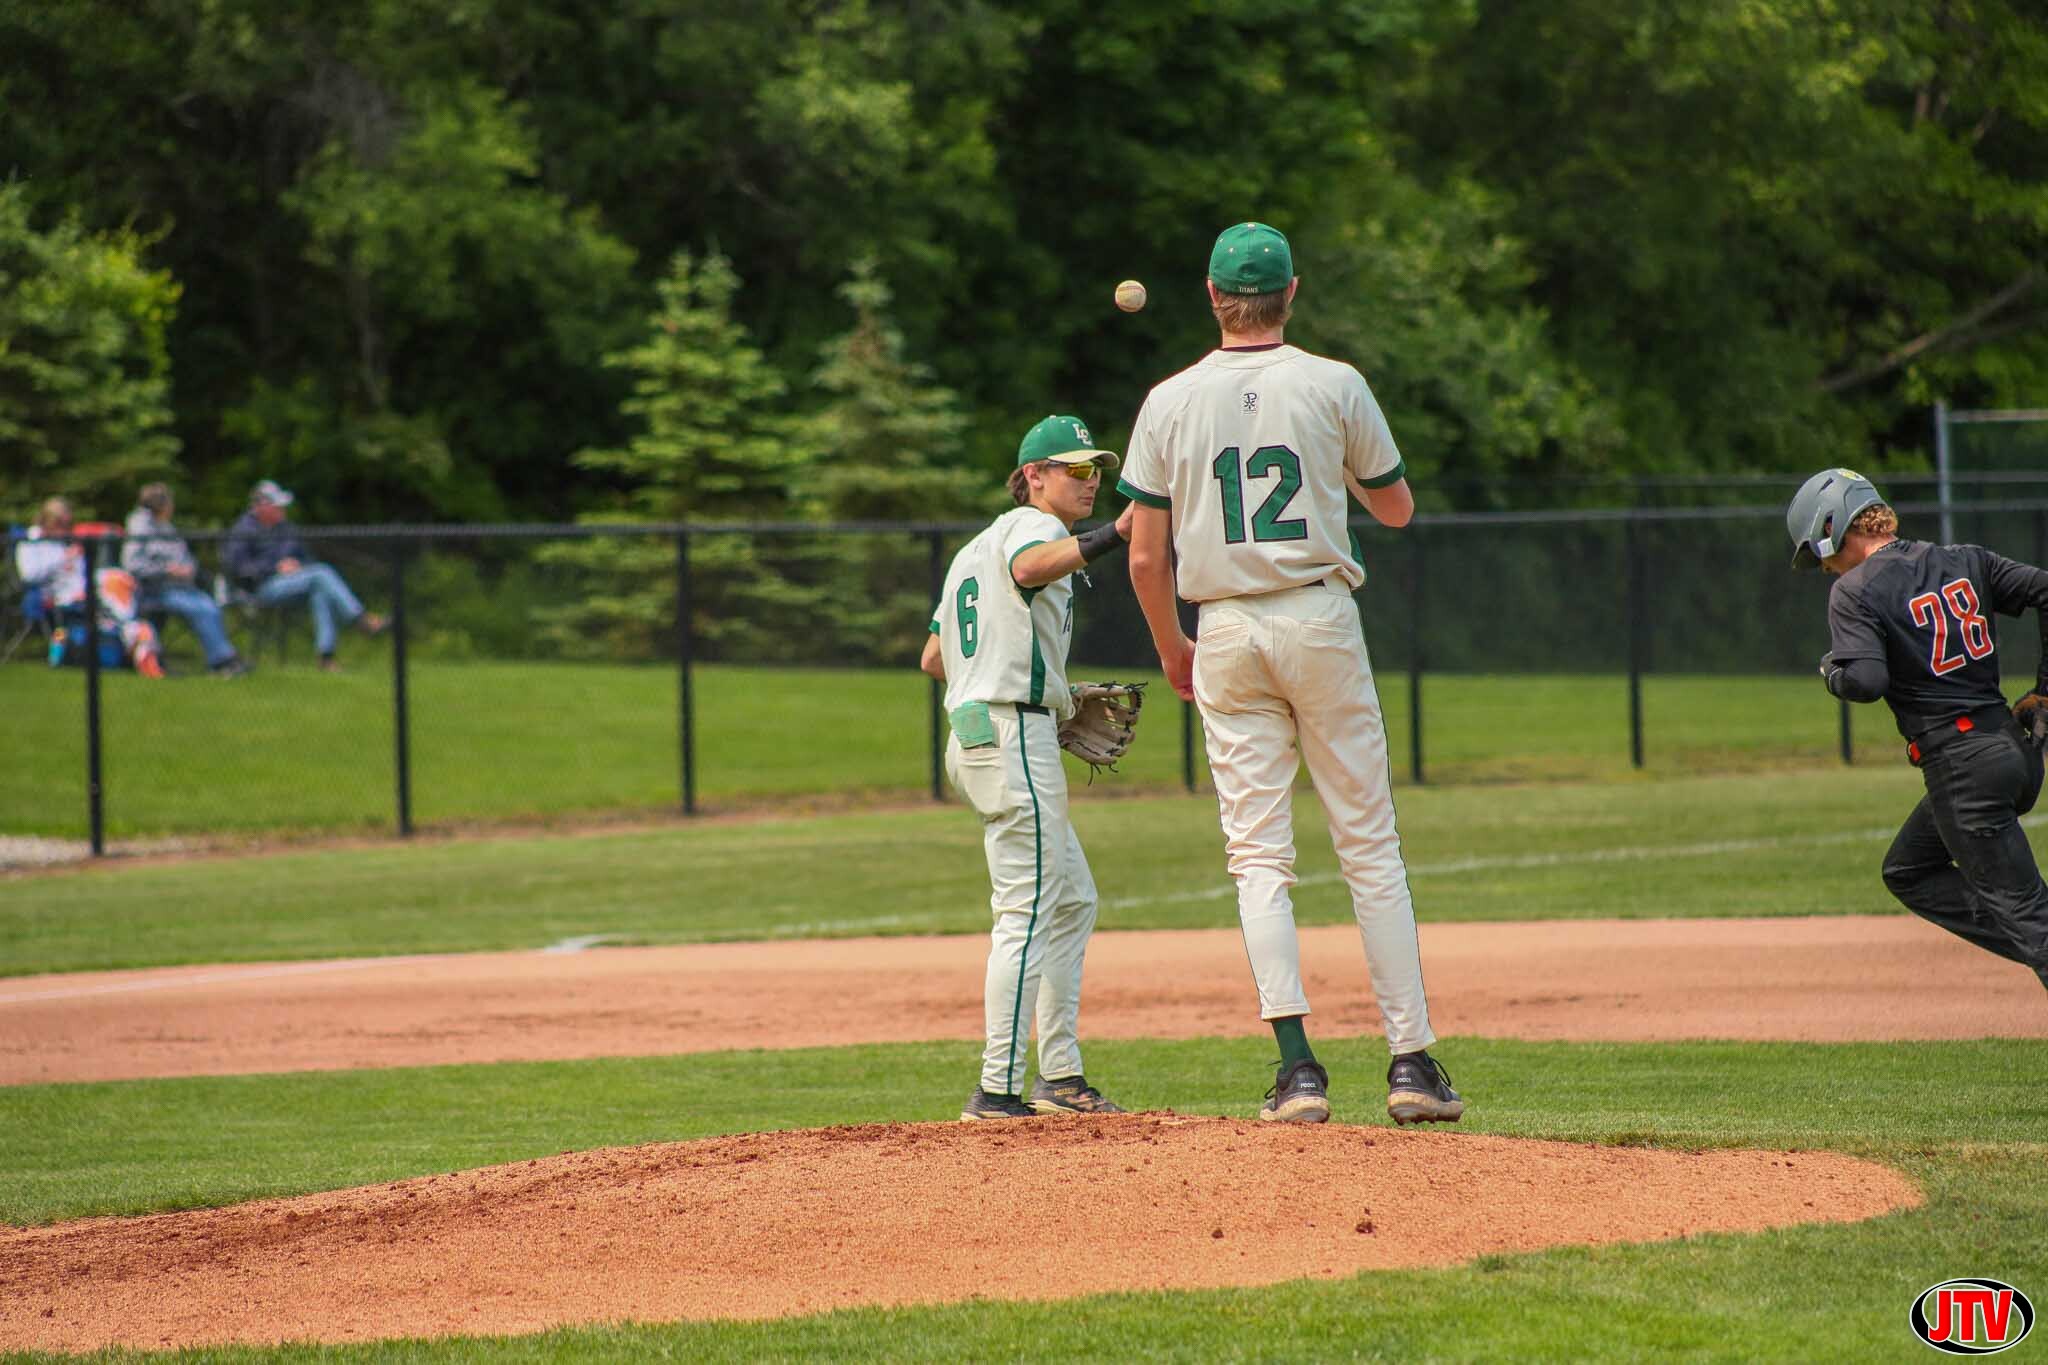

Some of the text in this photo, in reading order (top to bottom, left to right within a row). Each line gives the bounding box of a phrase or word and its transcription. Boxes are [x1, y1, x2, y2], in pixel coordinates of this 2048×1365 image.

[1239, 285, 1259, 294] TITANS
[1213, 445, 1308, 544] 12
[957, 576, 979, 659] 6
[1909, 578, 1994, 676] 28
